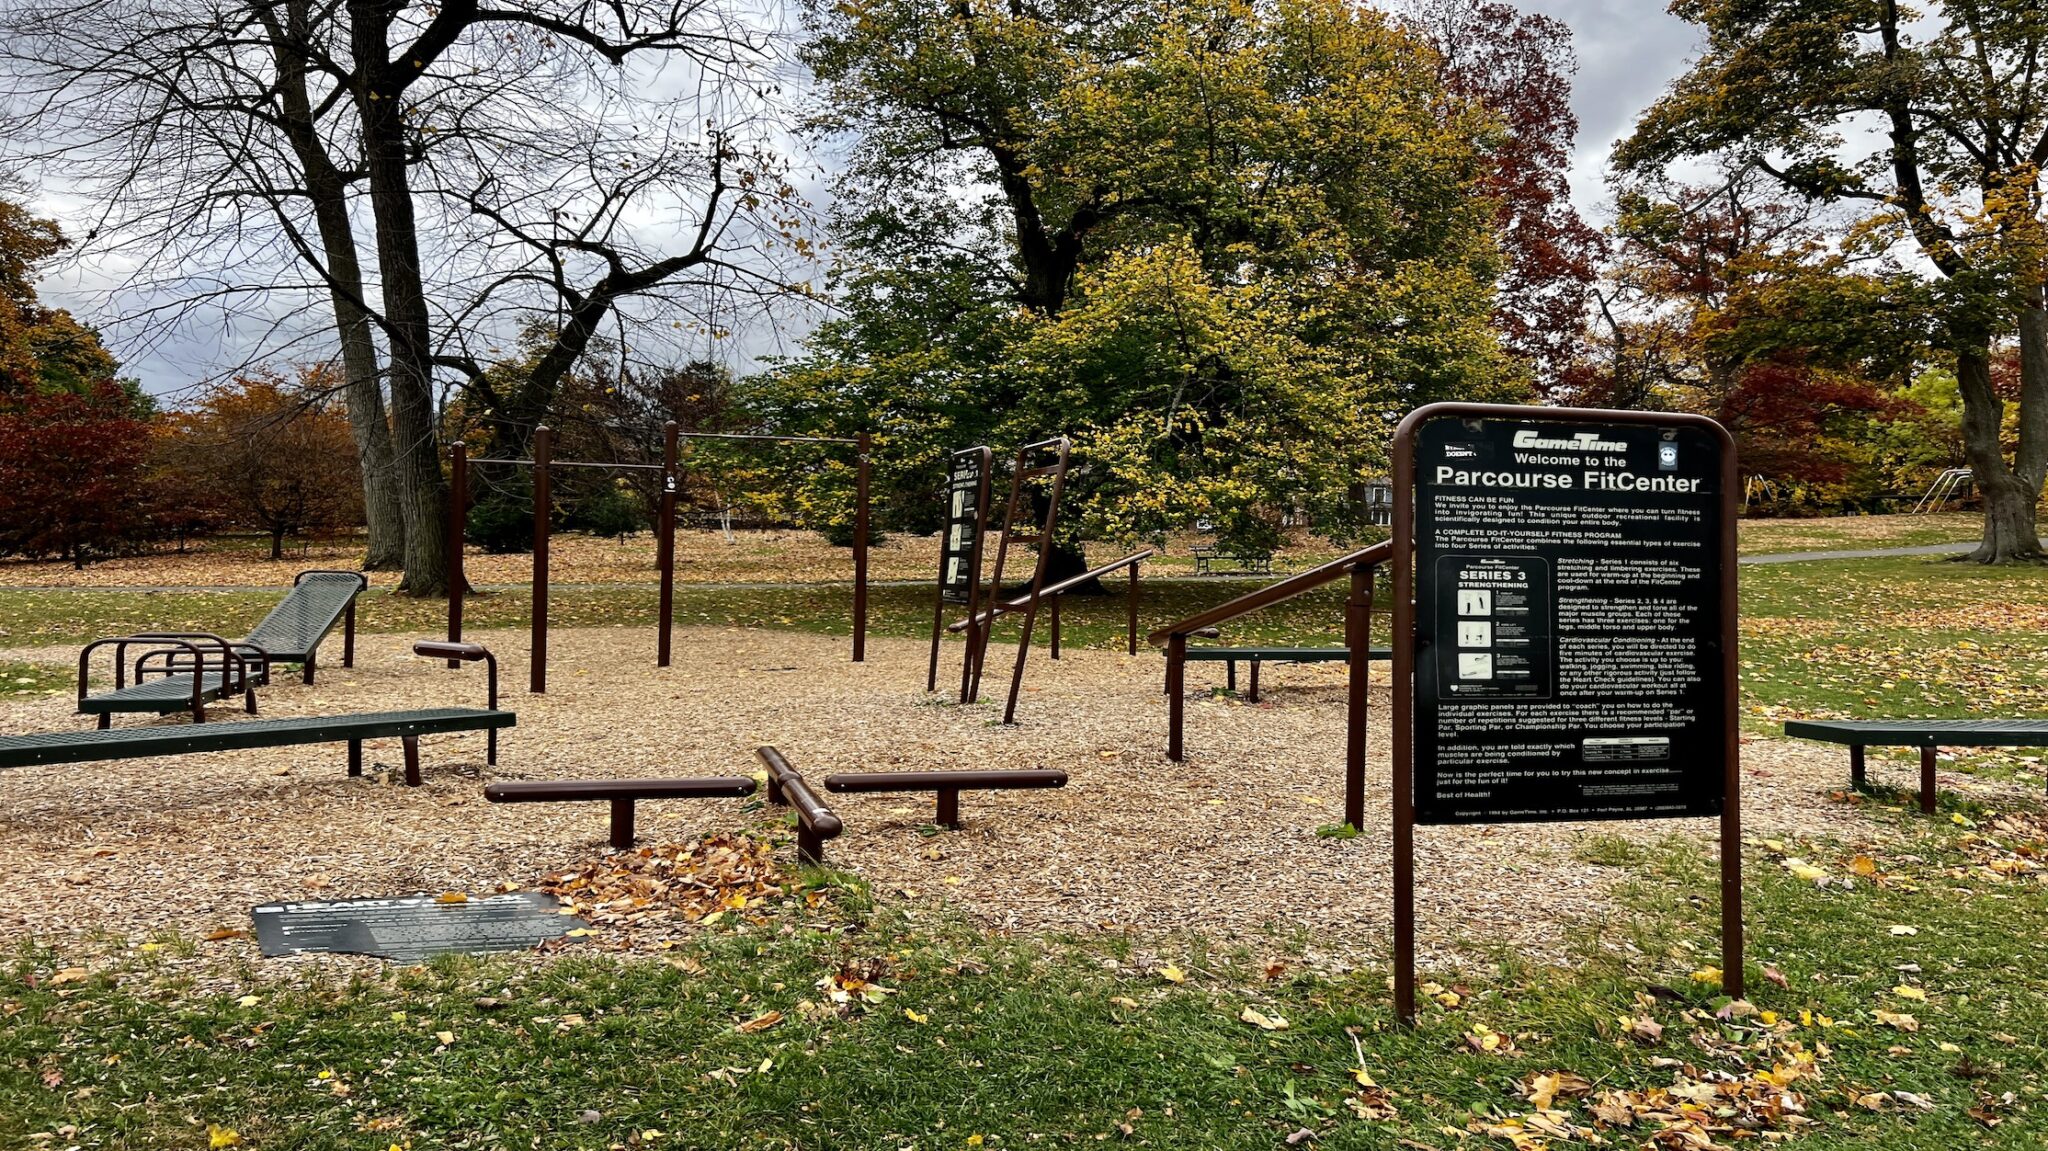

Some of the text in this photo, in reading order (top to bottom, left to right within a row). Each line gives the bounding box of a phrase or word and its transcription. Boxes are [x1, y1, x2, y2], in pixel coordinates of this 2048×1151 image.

[1512, 430, 1628, 452] GameTime
[1514, 453, 1626, 467] Welcome to the
[1436, 466, 1700, 492] Parcourse FitCenter
[1434, 515, 1480, 523] scientifically
[1482, 516, 1515, 524] designed
[1455, 509, 1502, 517] invigorating
[1550, 511, 1576, 520] unique
[1664, 514, 1688, 522] facility
[1576, 538, 1608, 546] following
[1642, 539, 1661, 548] types
[1557, 557, 1594, 565] Stretching
[1557, 563, 1592, 572] stretching
[1609, 564, 1642, 573] limbering
[1460, 571, 1526, 580] SERIES 3
[1558, 603, 1590, 611] designed
[1600, 603, 1637, 612] strengthen
[1612, 636, 1655, 644] Conditioning
[1454, 723, 1486, 732] Sporting
[1514, 722, 1566, 731] Championship
[1643, 721, 1686, 729] participation
[1526, 742, 1552, 751] exactly
[1484, 750, 1505, 758] being
[1437, 757, 1473, 766] particular
[1478, 770, 1504, 779] perfect
[1560, 768, 1570, 777] try
[1603, 768, 1631, 776] concept
